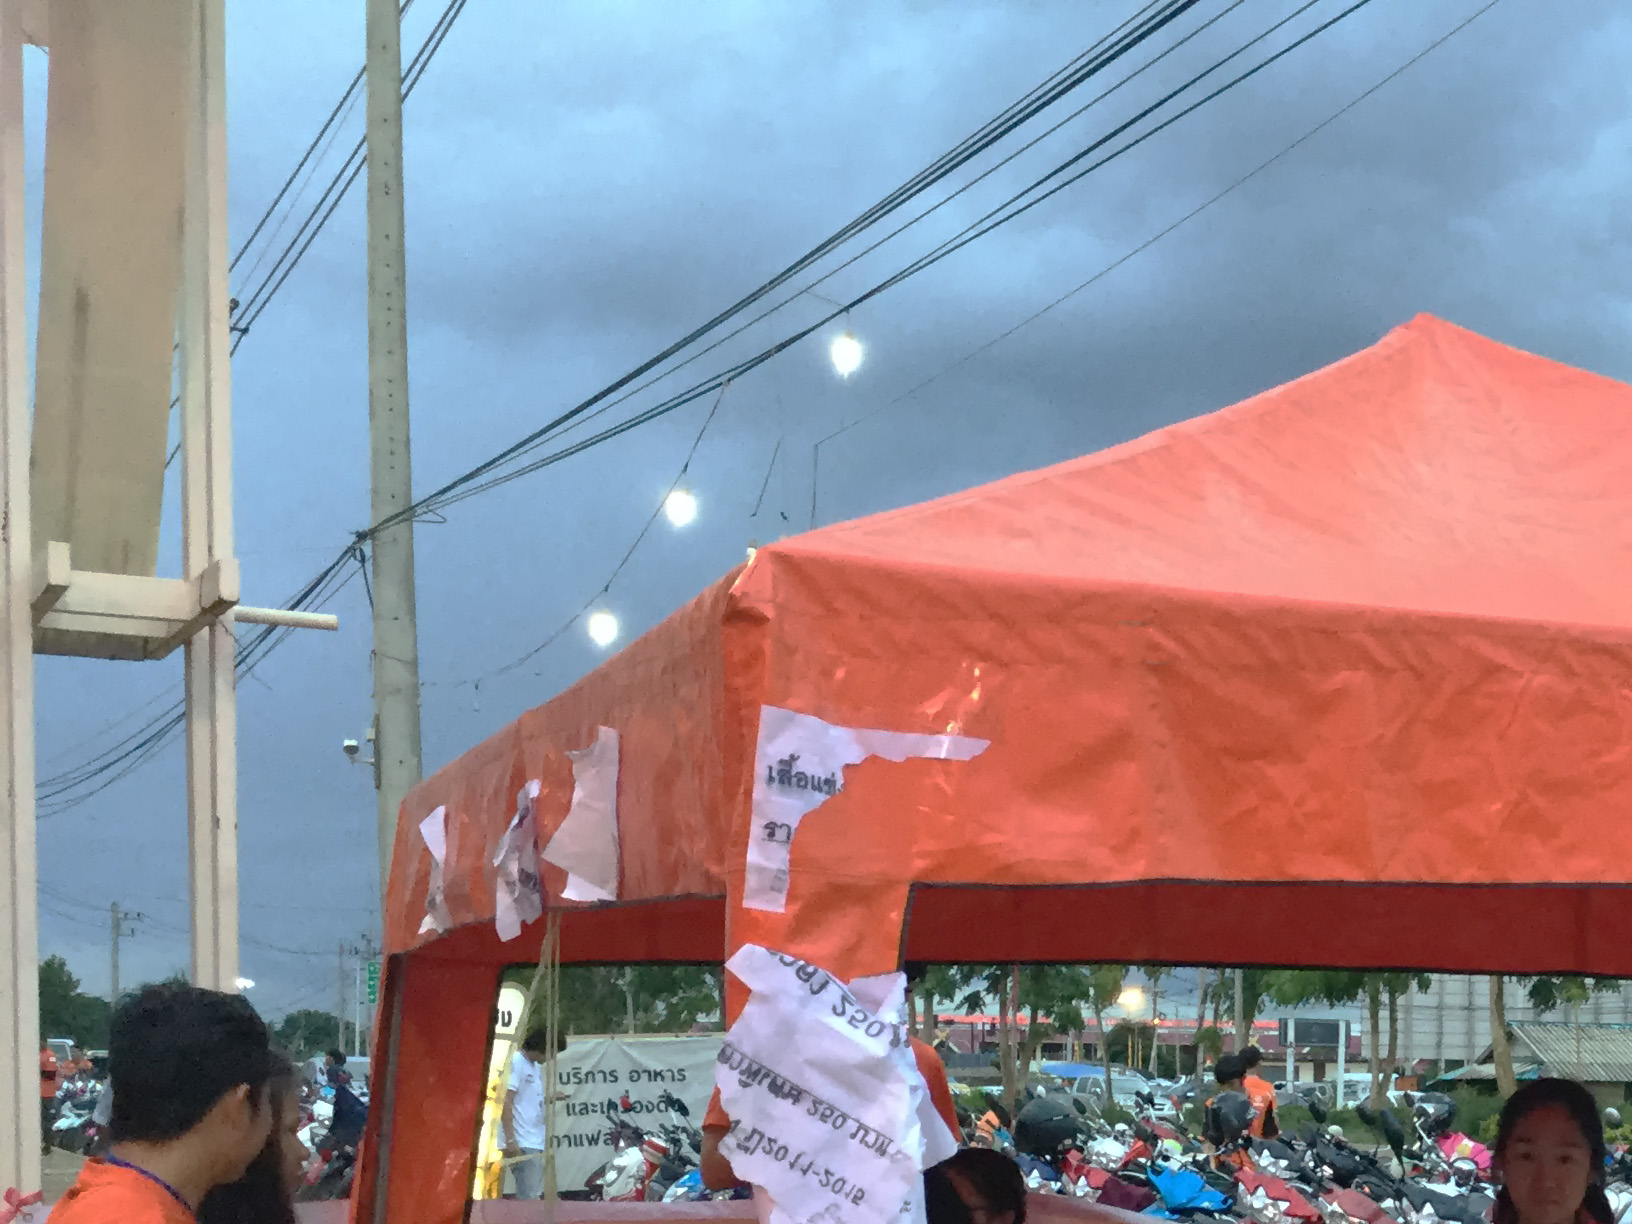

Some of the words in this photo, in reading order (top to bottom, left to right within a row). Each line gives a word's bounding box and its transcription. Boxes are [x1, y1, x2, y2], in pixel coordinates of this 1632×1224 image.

[558, 1067, 619, 1085] บริการ
[628, 1067, 687, 1084] อาหาร
